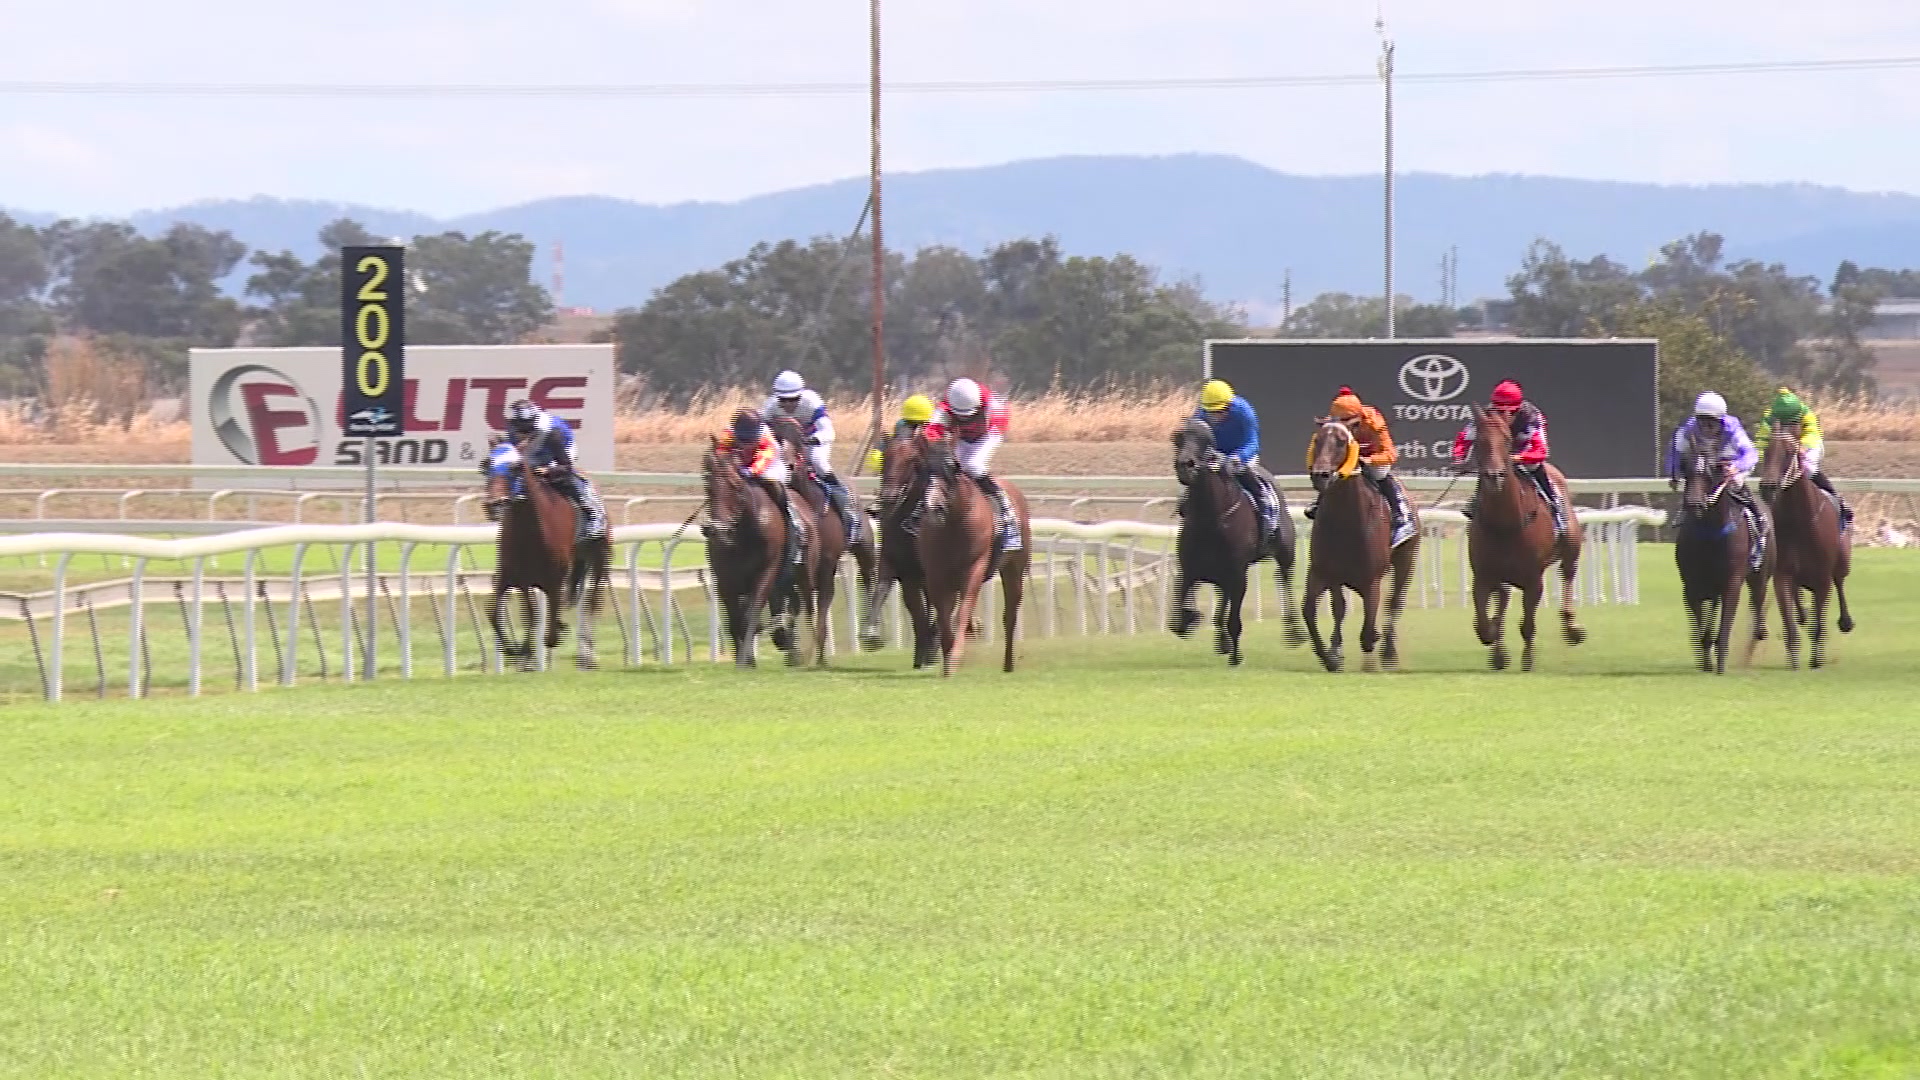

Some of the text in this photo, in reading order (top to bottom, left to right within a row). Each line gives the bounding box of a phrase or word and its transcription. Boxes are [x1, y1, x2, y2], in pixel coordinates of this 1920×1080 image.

[355, 255, 390, 398] 200
[335, 376, 588, 432] LITE
[1392, 404, 1475, 420] TOYOTA
[334, 438, 449, 465] SAND
